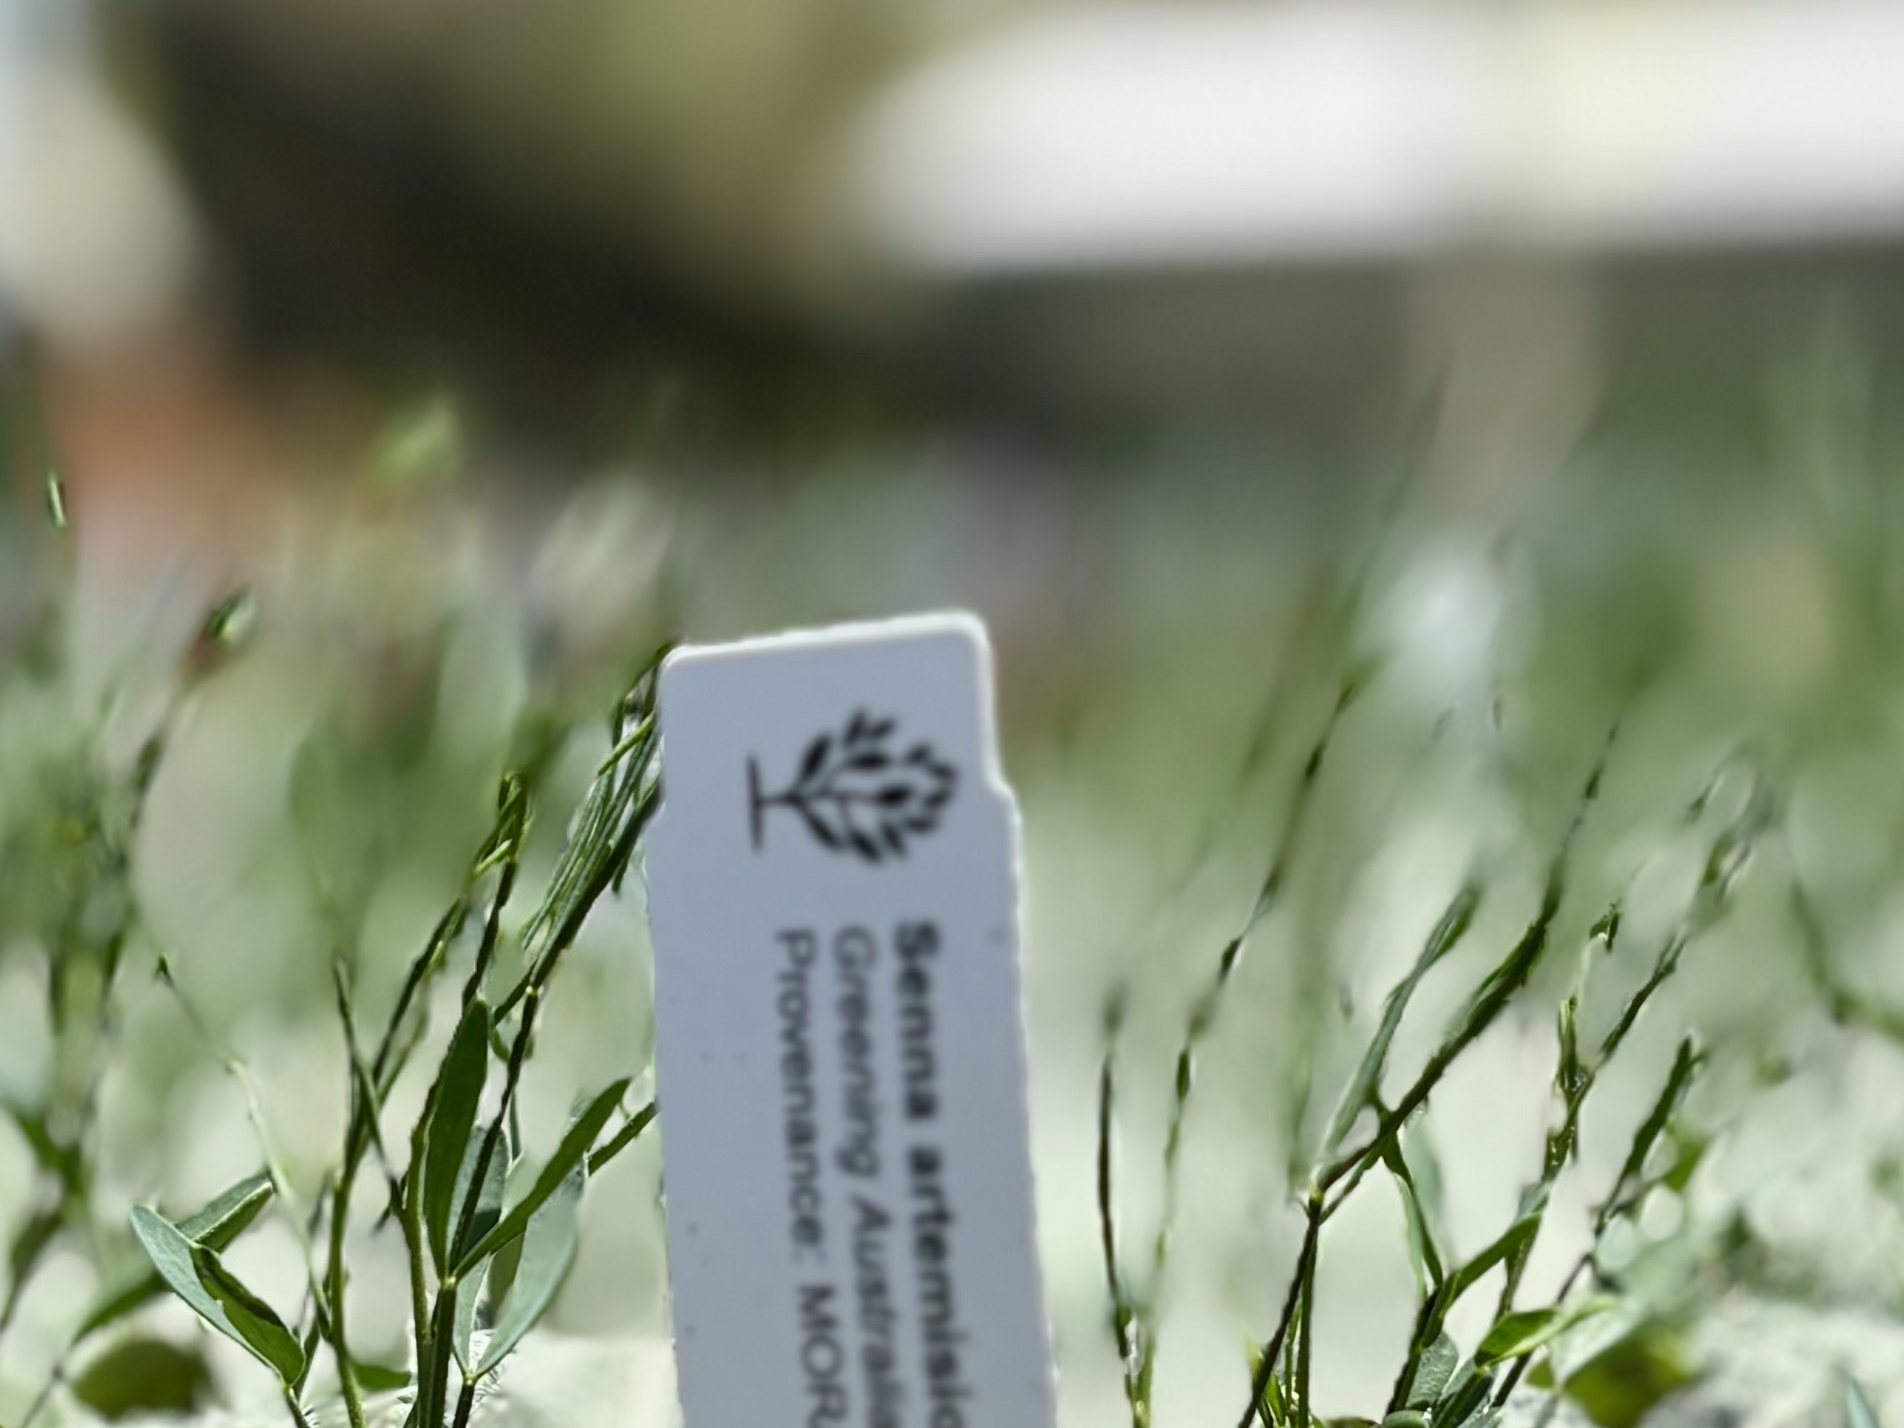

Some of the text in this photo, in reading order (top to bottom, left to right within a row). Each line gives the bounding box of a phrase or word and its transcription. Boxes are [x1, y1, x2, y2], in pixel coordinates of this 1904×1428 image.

[775, 928, 826, 1263] Provenance:
[833, 924, 881, 1176] Greening
[895, 921, 940, 1122] Senna
